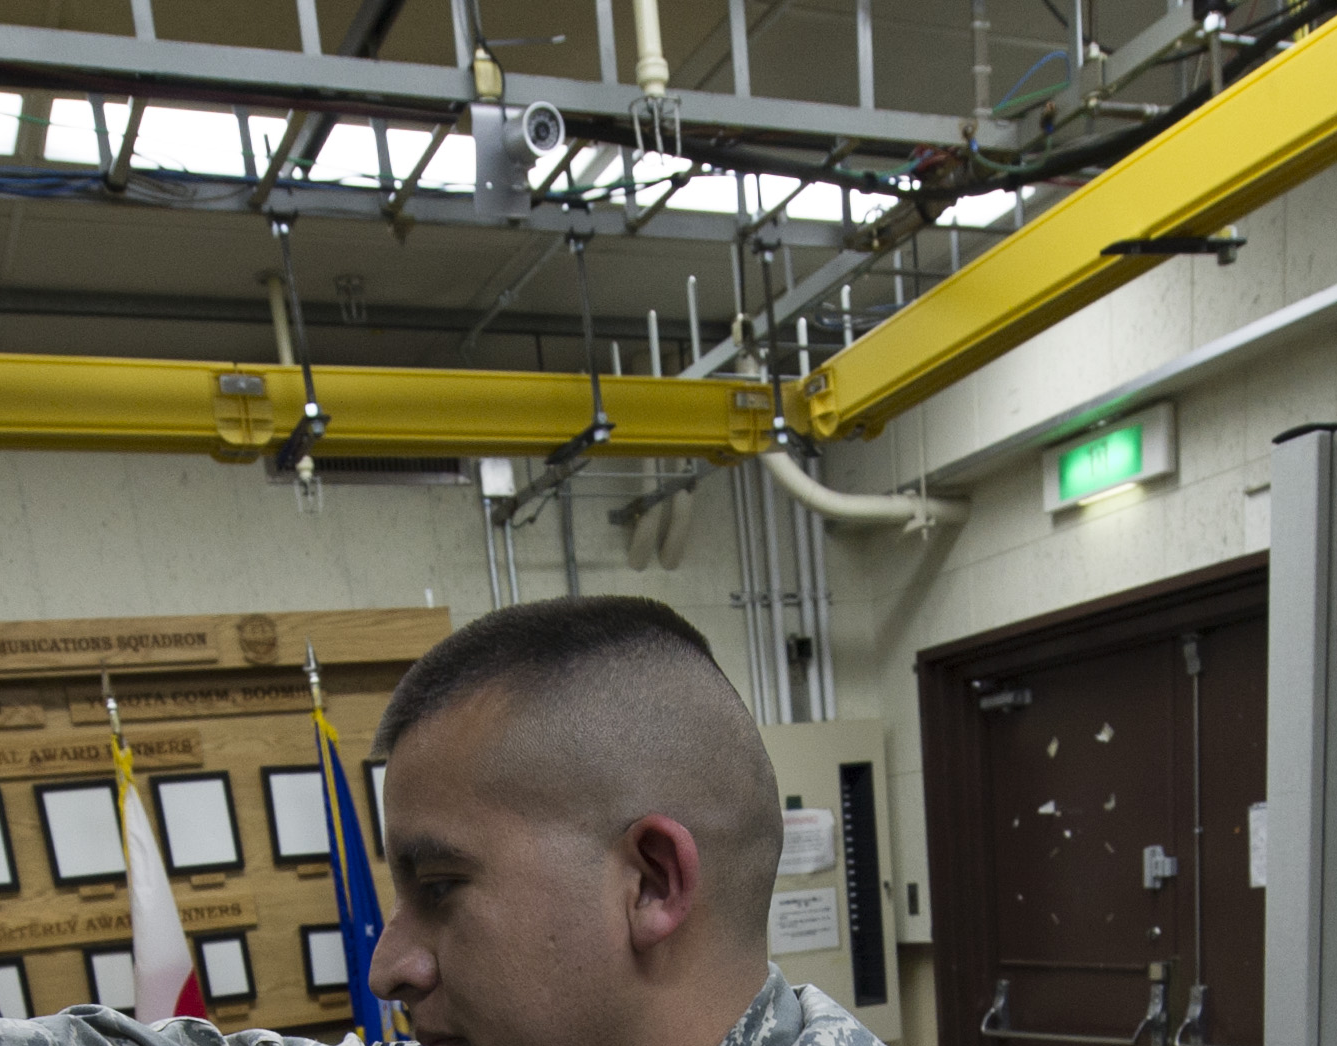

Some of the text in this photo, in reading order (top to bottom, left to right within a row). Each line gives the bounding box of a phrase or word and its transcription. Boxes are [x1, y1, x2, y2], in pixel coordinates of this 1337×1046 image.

[117, 631, 208, 653] SQUADRON
[28, 744, 100, 765] AWARD
[105, 738, 193, 760] NNERS
